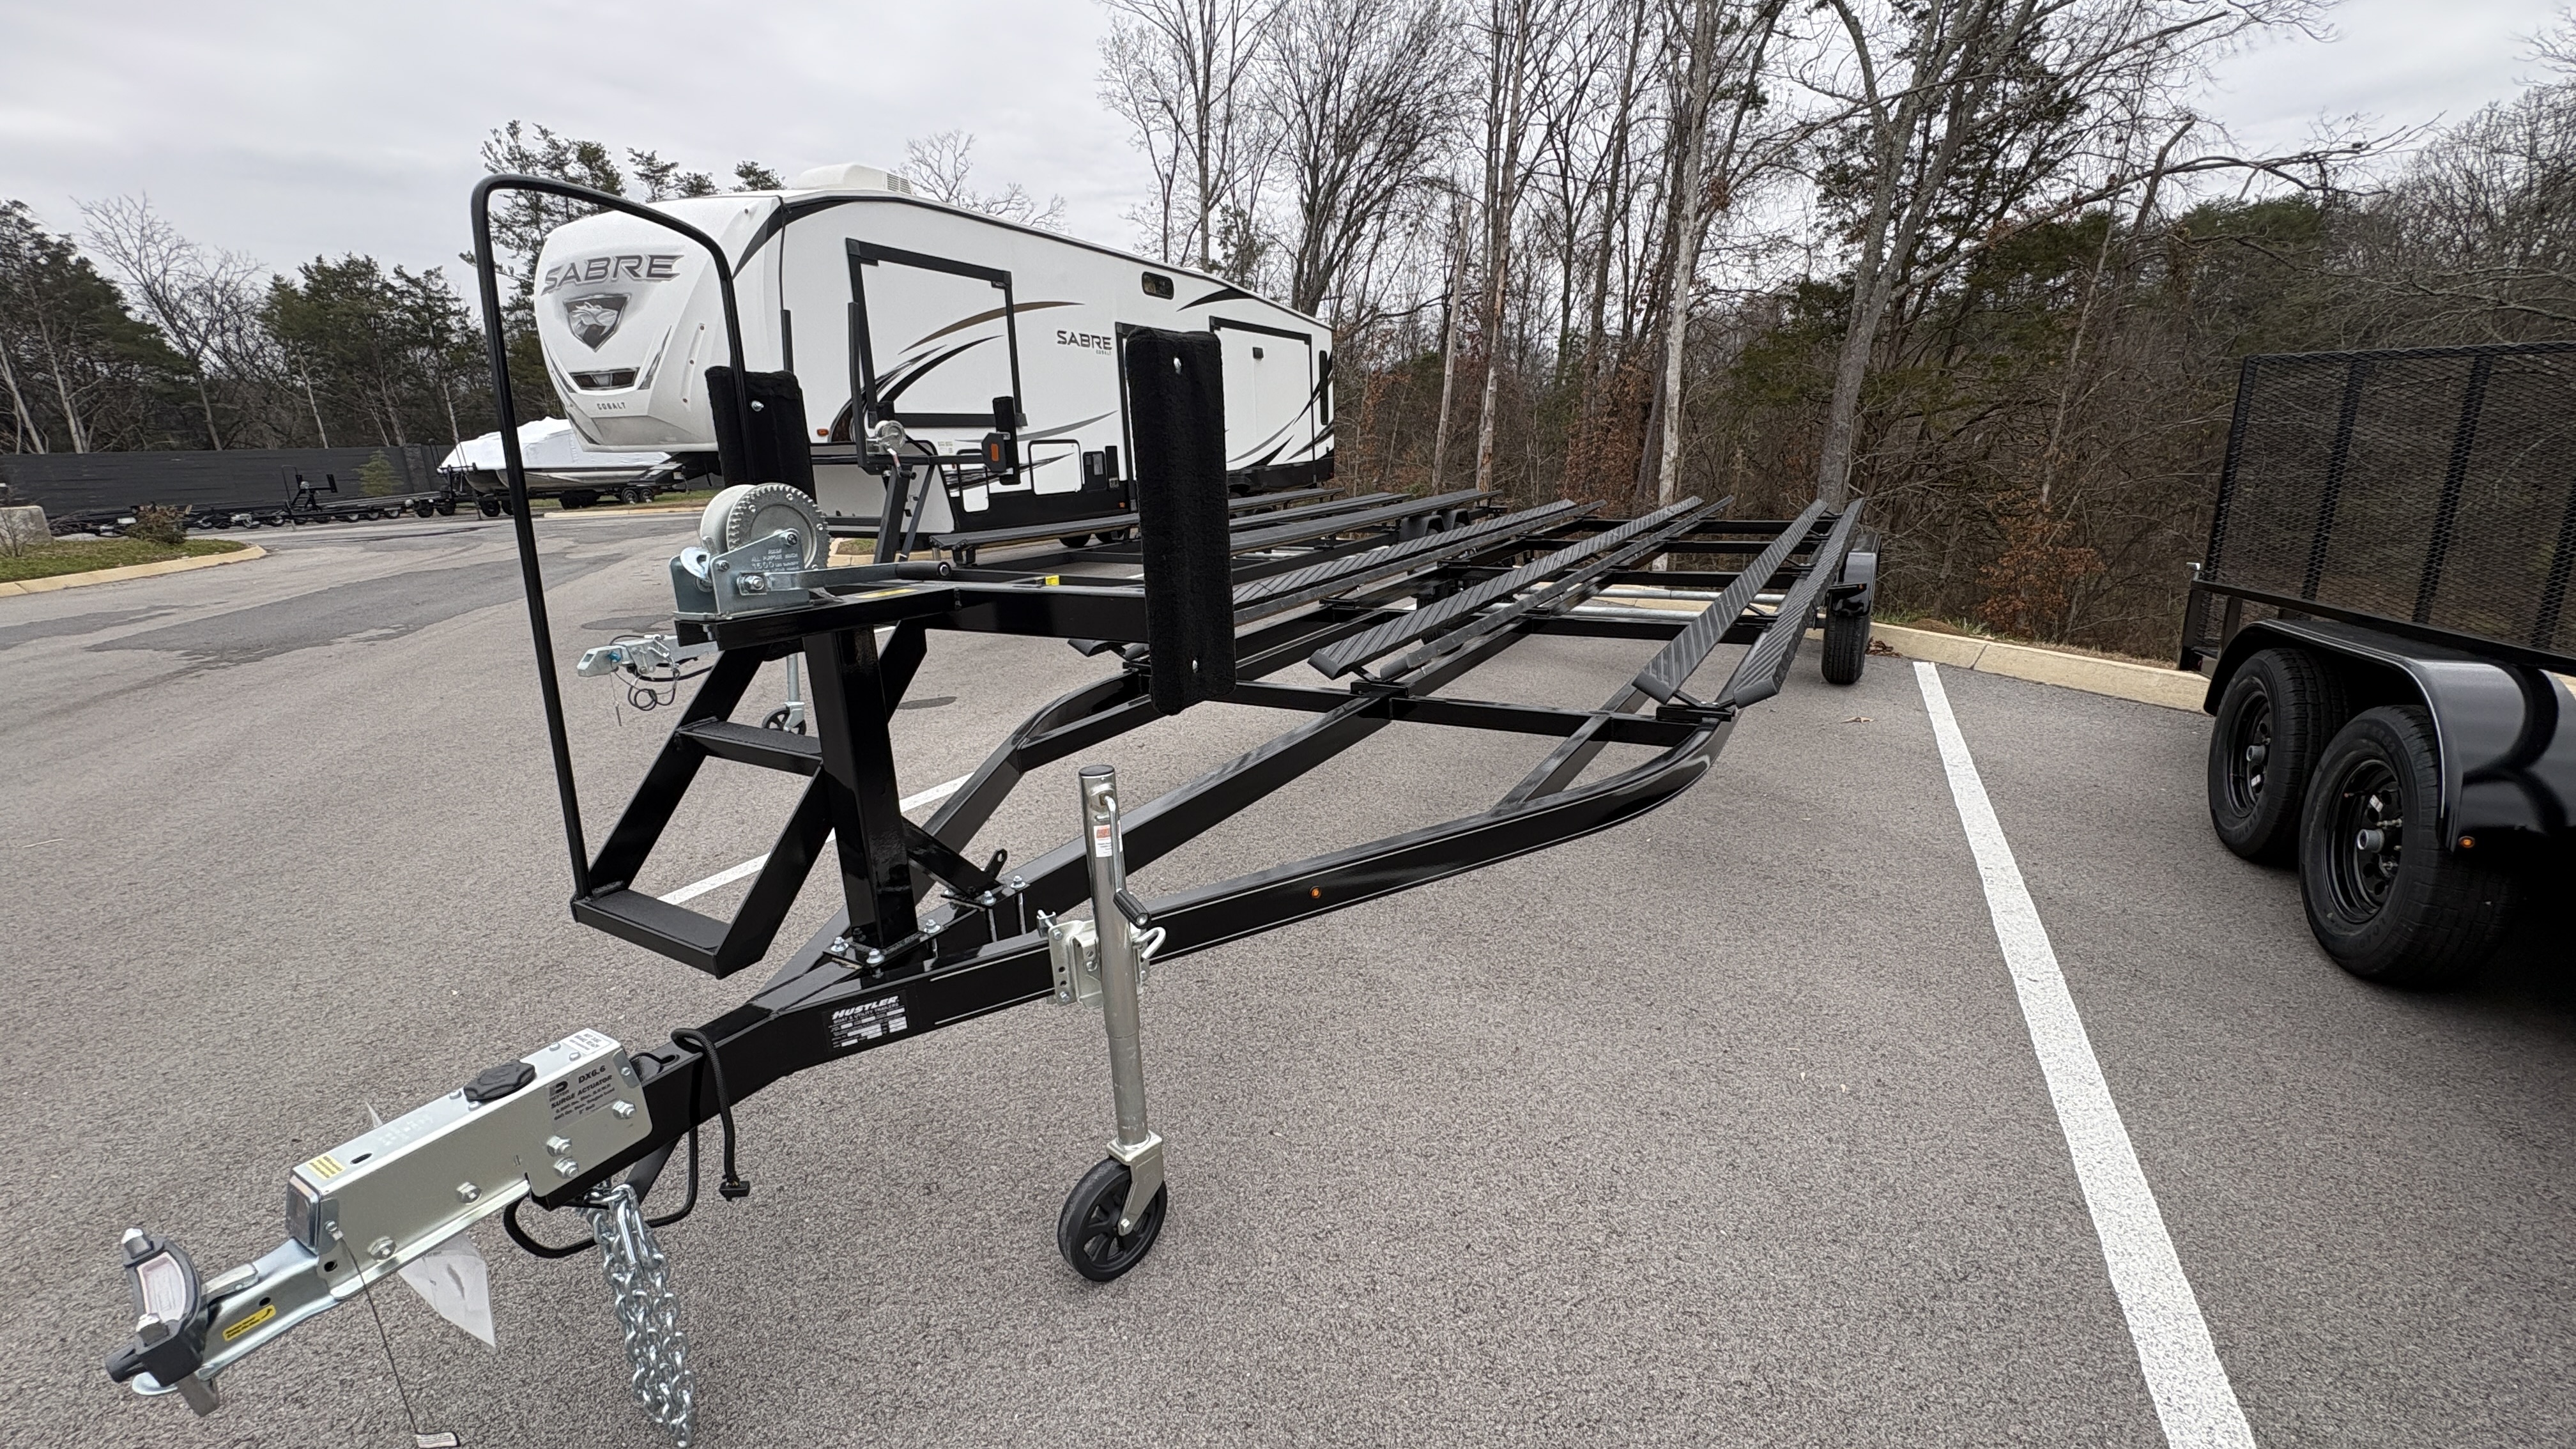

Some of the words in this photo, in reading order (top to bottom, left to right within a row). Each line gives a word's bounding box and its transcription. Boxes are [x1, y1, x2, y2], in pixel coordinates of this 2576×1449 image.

[541, 254, 685, 296] SABRE
[1057, 330, 1112, 350] SABRE
[597, 402, 625, 410] COBALT
[832, 996, 898, 1020] HUSTLER
[854, 1010, 873, 1019] UTILITY
[875, 1002, 899, 1012] TRAILERS
[551, 1093, 575, 1108] SURGE
[578, 1075, 612, 1096] ACTUATOR
